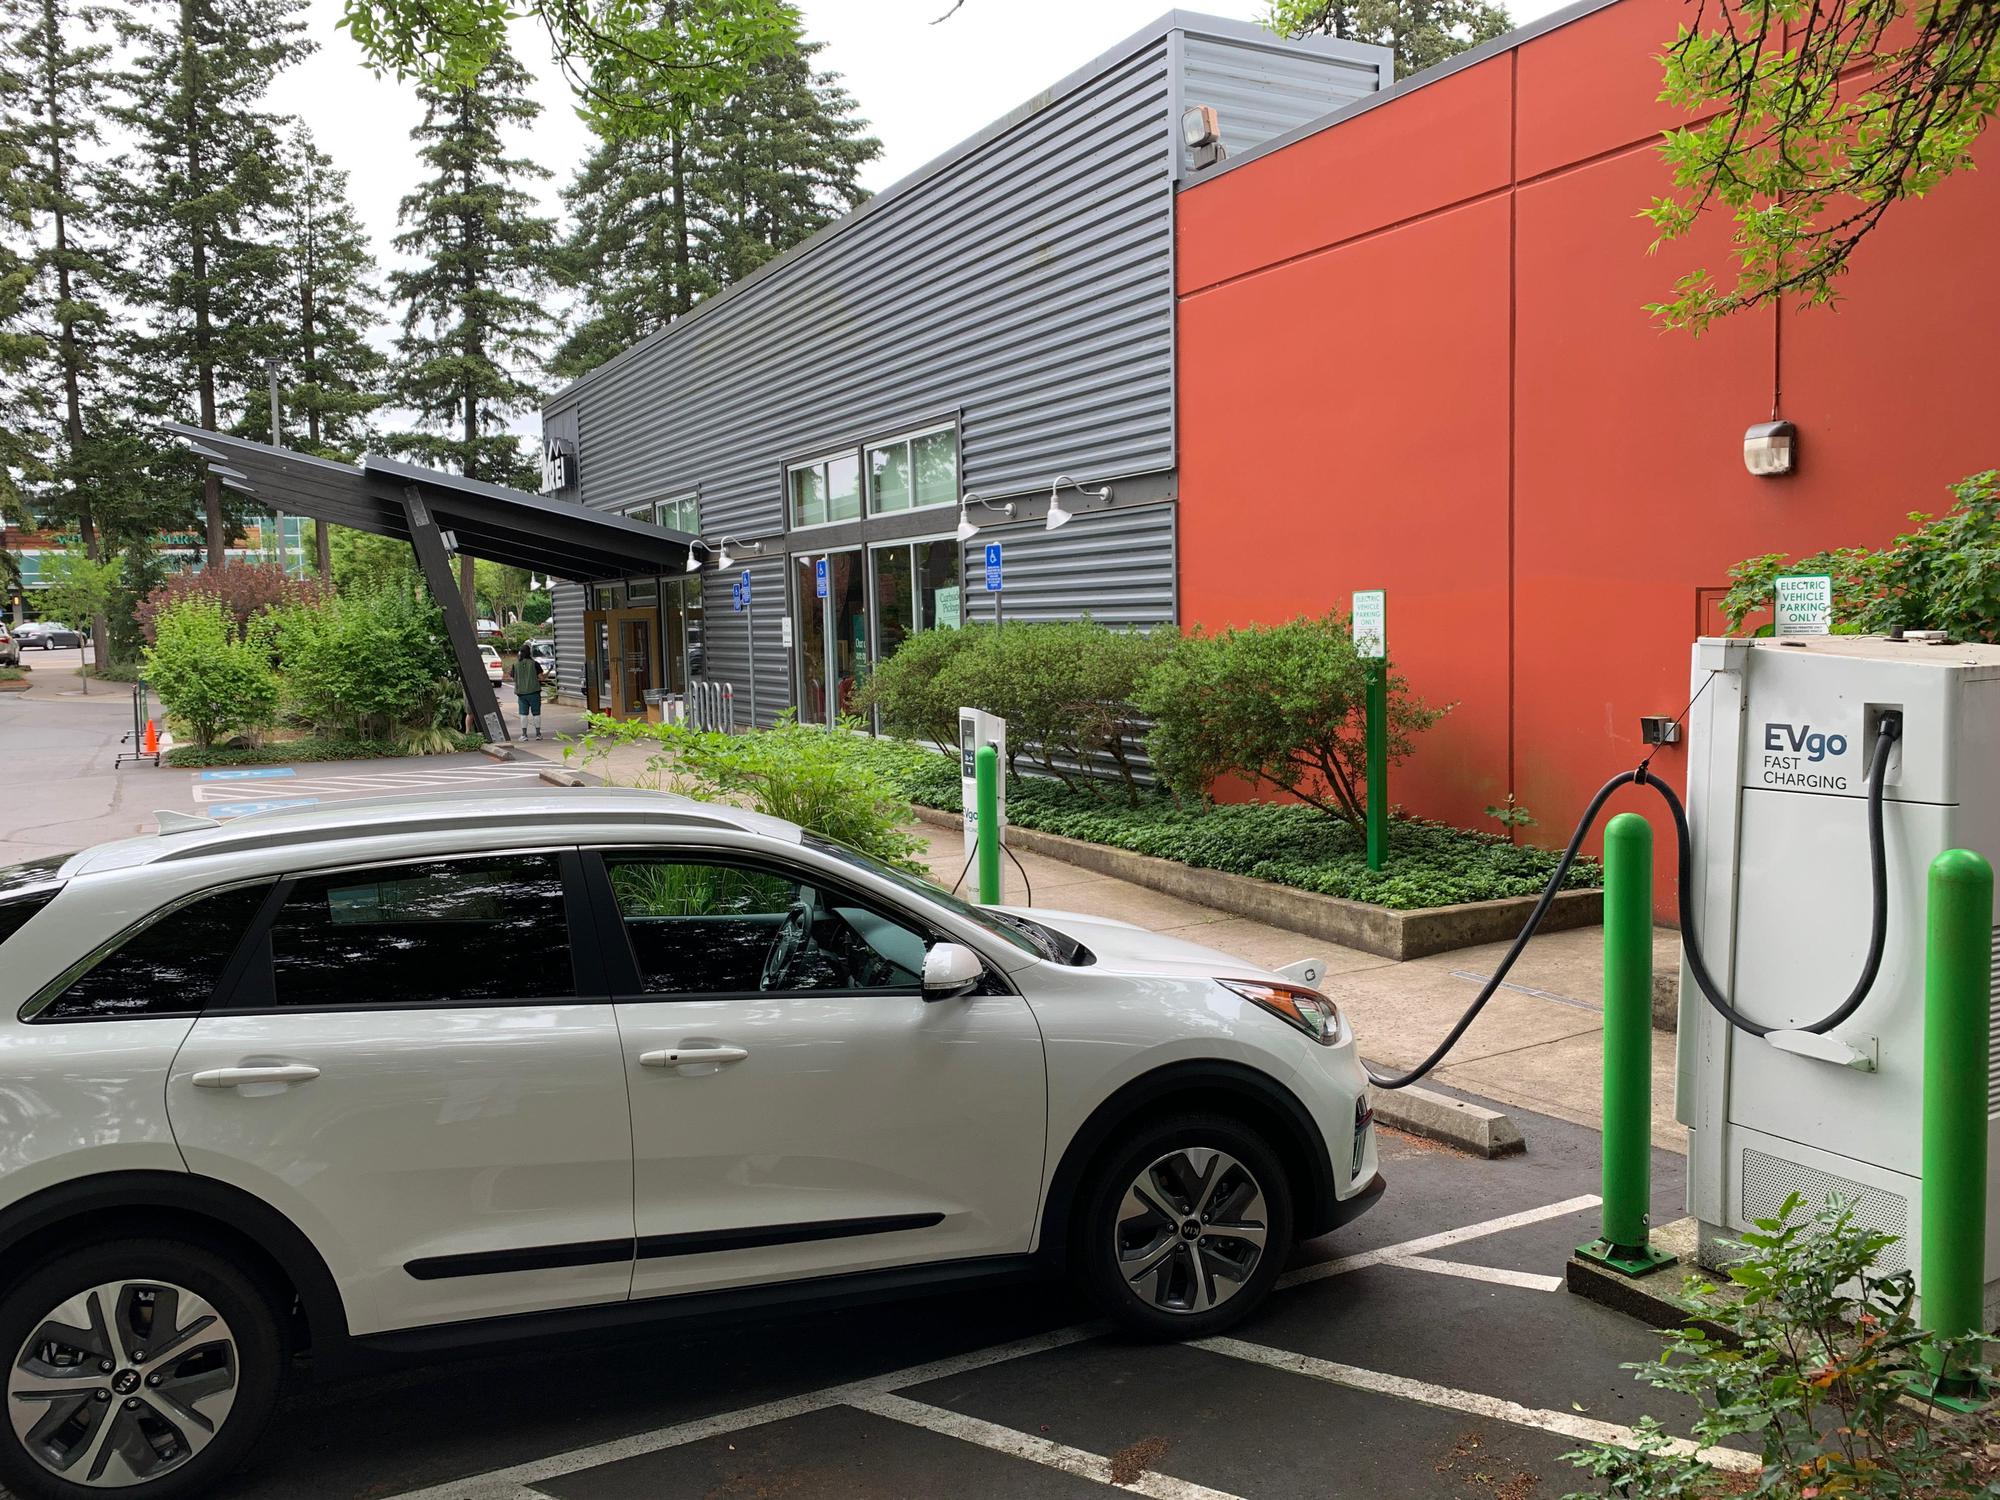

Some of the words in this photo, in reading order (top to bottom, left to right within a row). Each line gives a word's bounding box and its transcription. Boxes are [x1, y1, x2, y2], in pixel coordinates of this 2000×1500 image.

[1780, 581, 1825, 591] ELECTRIC
[1782, 592, 1824, 601] VEHICLE
[1780, 603, 1826, 611] PARKING
[1789, 613, 1817, 622] ONLY
[1765, 723, 1847, 762] EVgo
[1764, 755, 1801, 770] FAST
[1763, 771, 1847, 790] CHARGING
